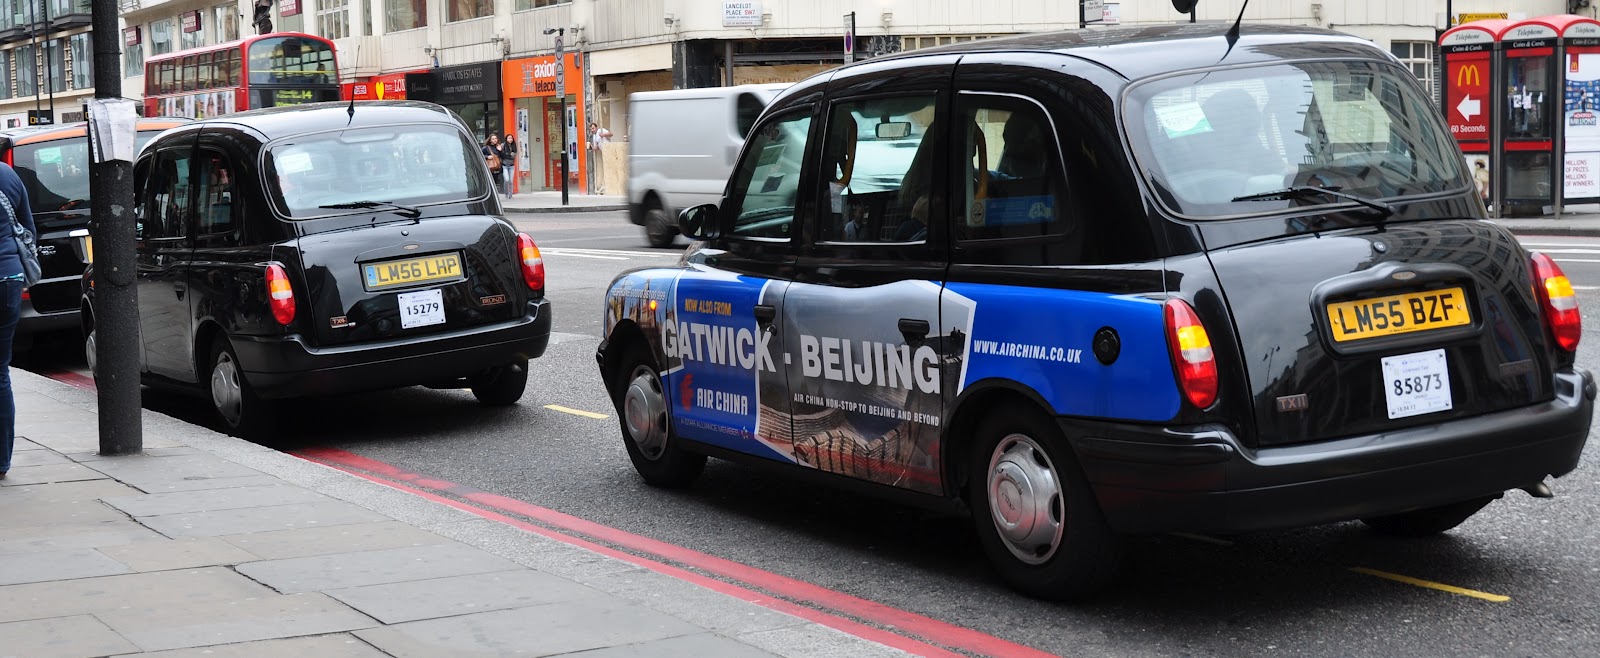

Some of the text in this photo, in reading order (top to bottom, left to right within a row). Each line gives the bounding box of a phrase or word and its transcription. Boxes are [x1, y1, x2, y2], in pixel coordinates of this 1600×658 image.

[463, 68, 483, 79] ESTATES
[535, 80, 557, 92] teleco
[1450, 124, 1486, 133] 60 Seconds
[377, 258, 456, 282] LM56 LHP
[406, 302, 439, 315] 15279
[482, 296, 503, 304] BRONZE
[685, 298, 732, 316] NOW ALSO FROM
[1337, 293, 1455, 335] LM55 BZF
[661, 318, 777, 372] GATWICK
[800, 334, 940, 394] BEIJING
[973, 339, 1082, 364] WWW.AIRCHINA.CO.UK
[1393, 373, 1442, 396] 85873
[696, 387, 748, 416] AIR CHINA
[793, 392, 940, 427] AIR CHINA NON-STOP TO BEIJING AND BEYOND
